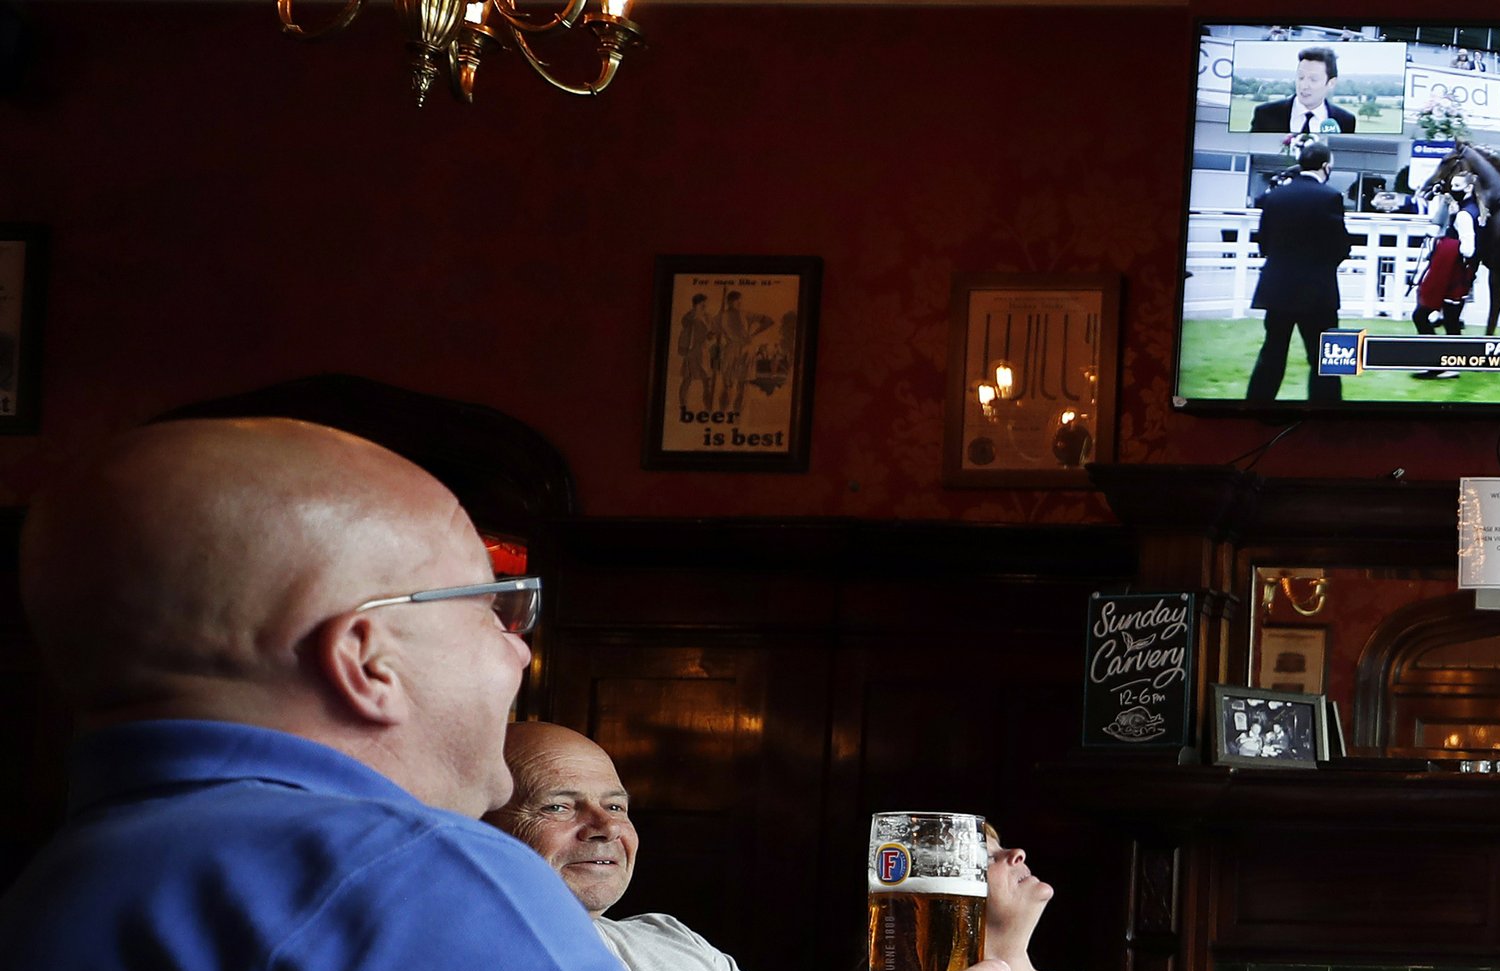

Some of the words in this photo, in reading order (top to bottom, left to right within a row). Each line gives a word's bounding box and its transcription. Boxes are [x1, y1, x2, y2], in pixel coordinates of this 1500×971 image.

[1324, 343, 1356, 358] itv
[1321, 358, 1357, 366] RACING
[1440, 355, 1466, 367] SON
[1469, 356, 1486, 367] OF
[679, 405, 740, 424] beer
[703, 428, 725, 446] is
[731, 428, 784, 447] best
[1094, 599, 1187, 640] Sunday
[1090, 639, 1186, 689] Carvery
[881, 850, 899, 881] F
